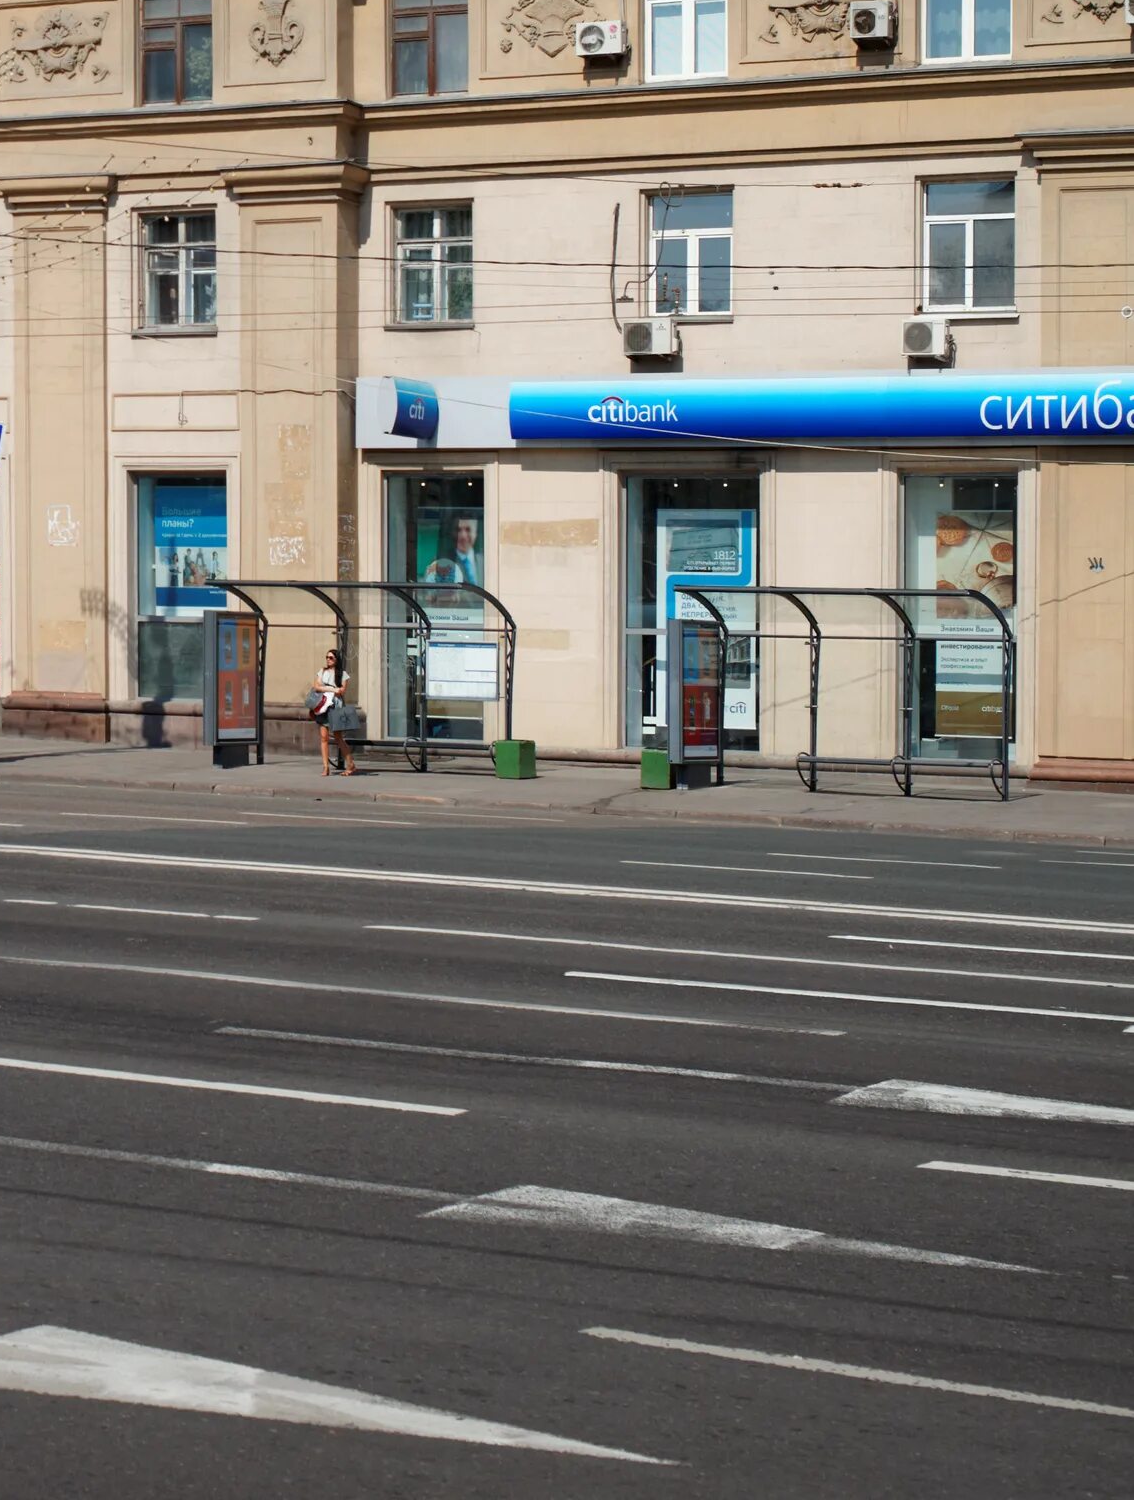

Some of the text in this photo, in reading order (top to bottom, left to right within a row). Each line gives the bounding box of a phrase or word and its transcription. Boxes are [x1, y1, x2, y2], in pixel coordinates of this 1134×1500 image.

[409, 397, 424, 421] citi
[587, 396, 679, 423] citibank
[161, 518, 195, 529] планы?
[713, 550, 736, 560] 1812
[729, 701, 747, 714] citi
